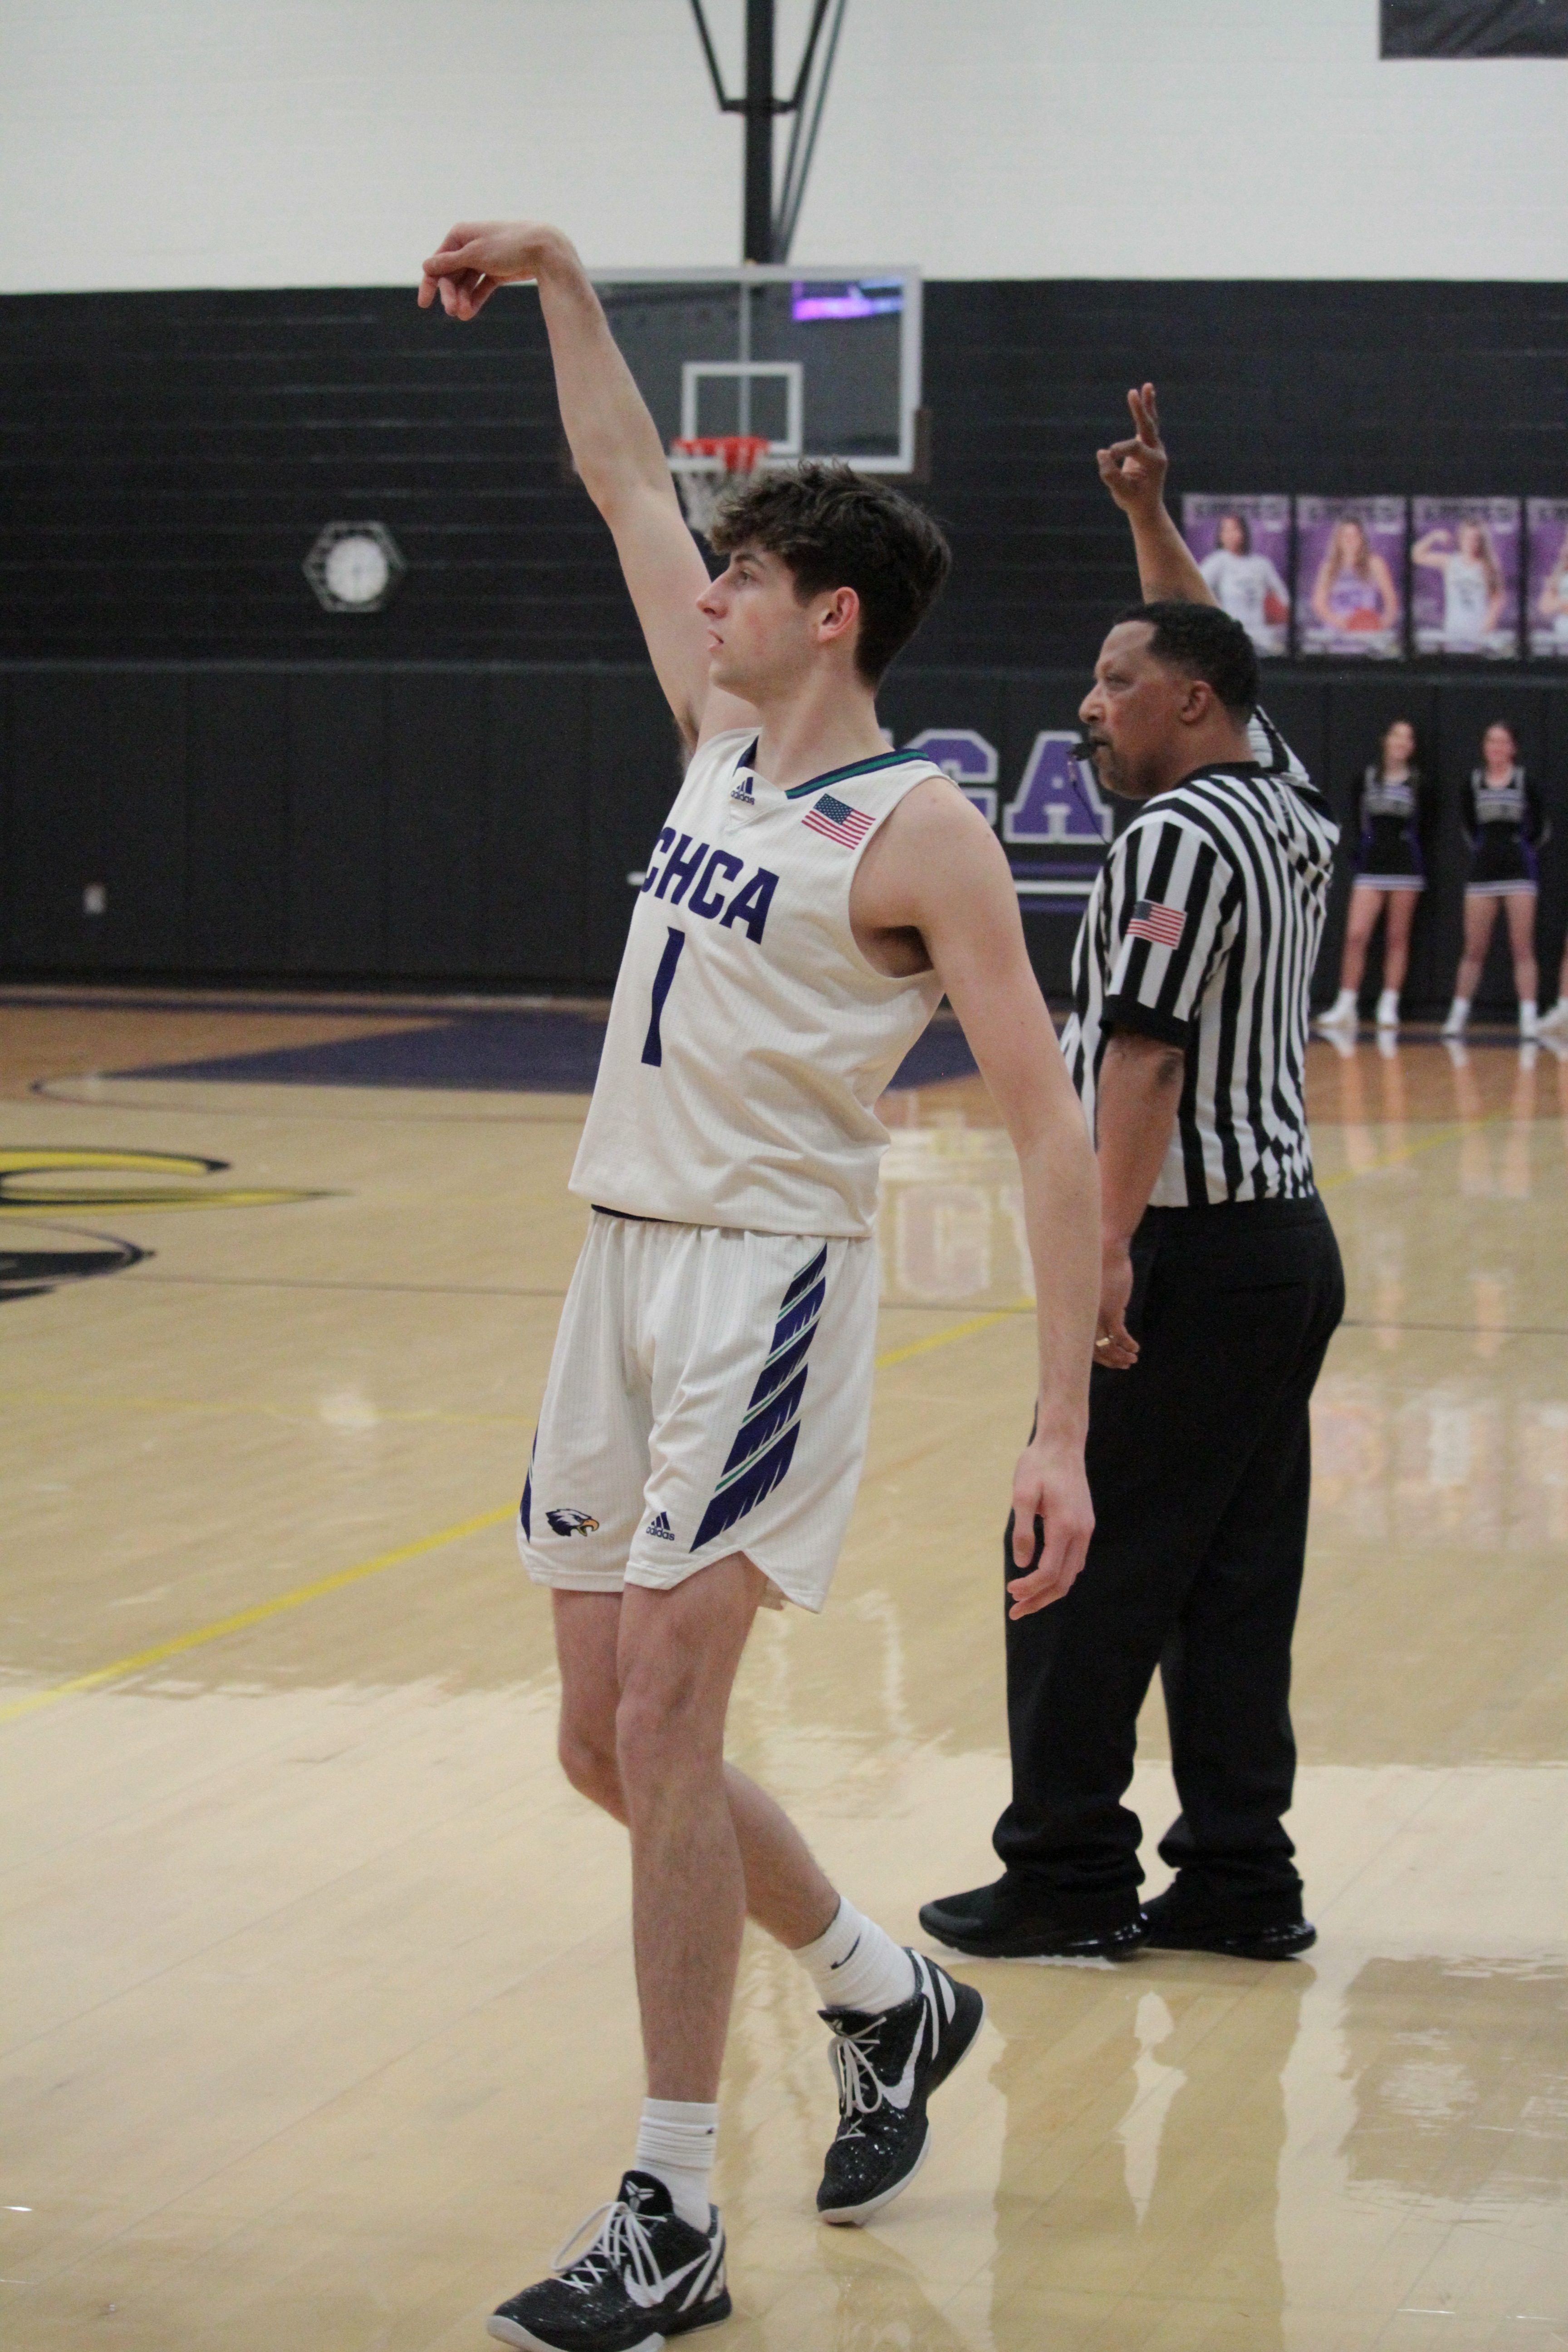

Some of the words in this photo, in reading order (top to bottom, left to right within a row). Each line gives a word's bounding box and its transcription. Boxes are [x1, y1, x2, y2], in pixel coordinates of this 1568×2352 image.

[730, 790, 755, 805] adidas
[641, 827, 779, 945] CHCA
[641, 926, 685, 1067] 1
[646, 1526, 675, 1541] adidas
